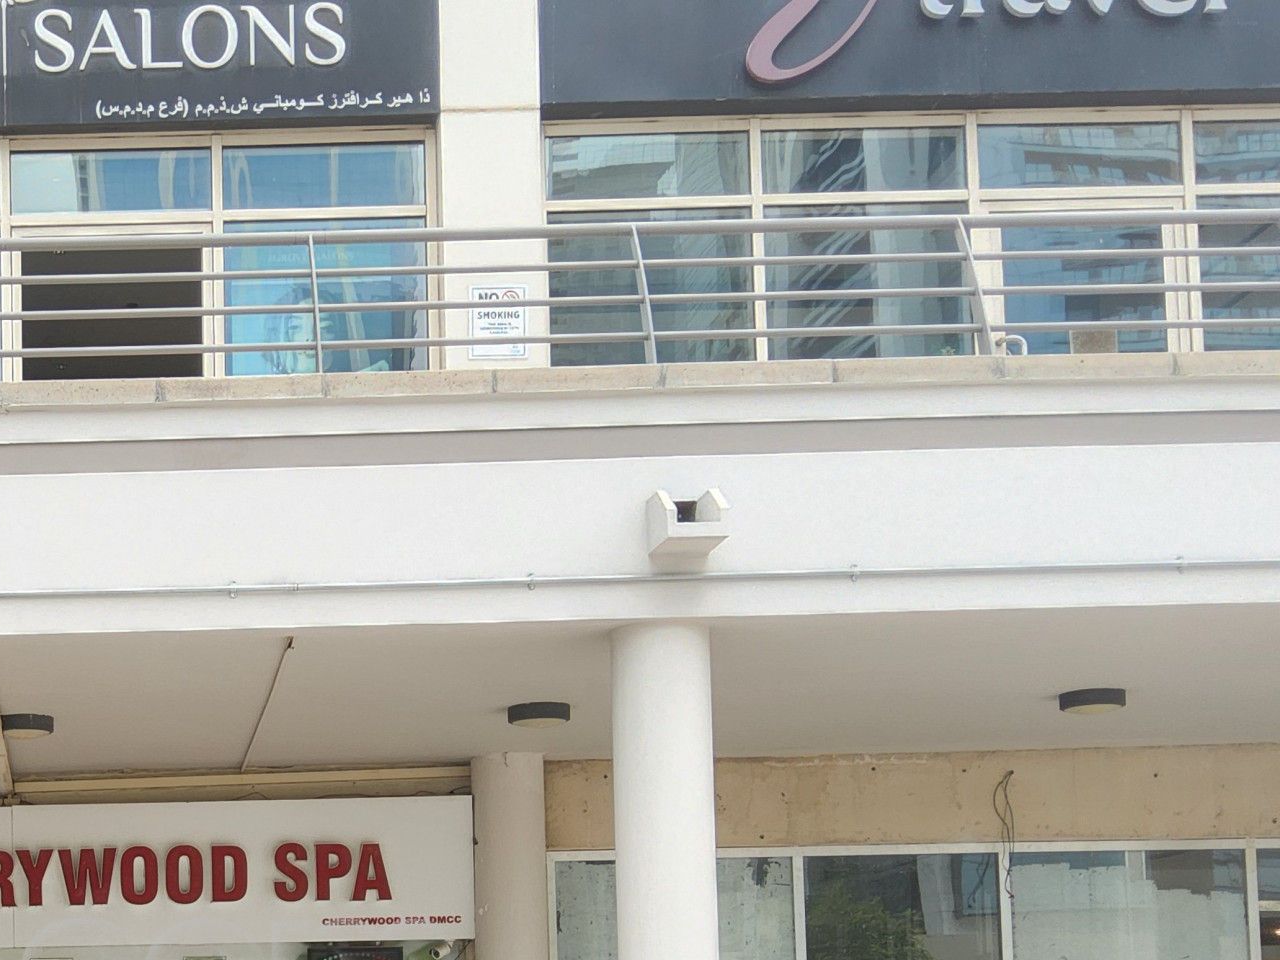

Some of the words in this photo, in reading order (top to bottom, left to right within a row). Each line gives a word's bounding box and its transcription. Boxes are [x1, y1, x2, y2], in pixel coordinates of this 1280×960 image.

[34, 2, 347, 74] SALONS
[477, 311, 520, 320] SMOKING
[272, 842, 393, 904] SPA
[322, 917, 401, 926] CHERRYWOOD
[405, 916, 426, 925] SPA
[429, 915, 462, 924] DMCC
